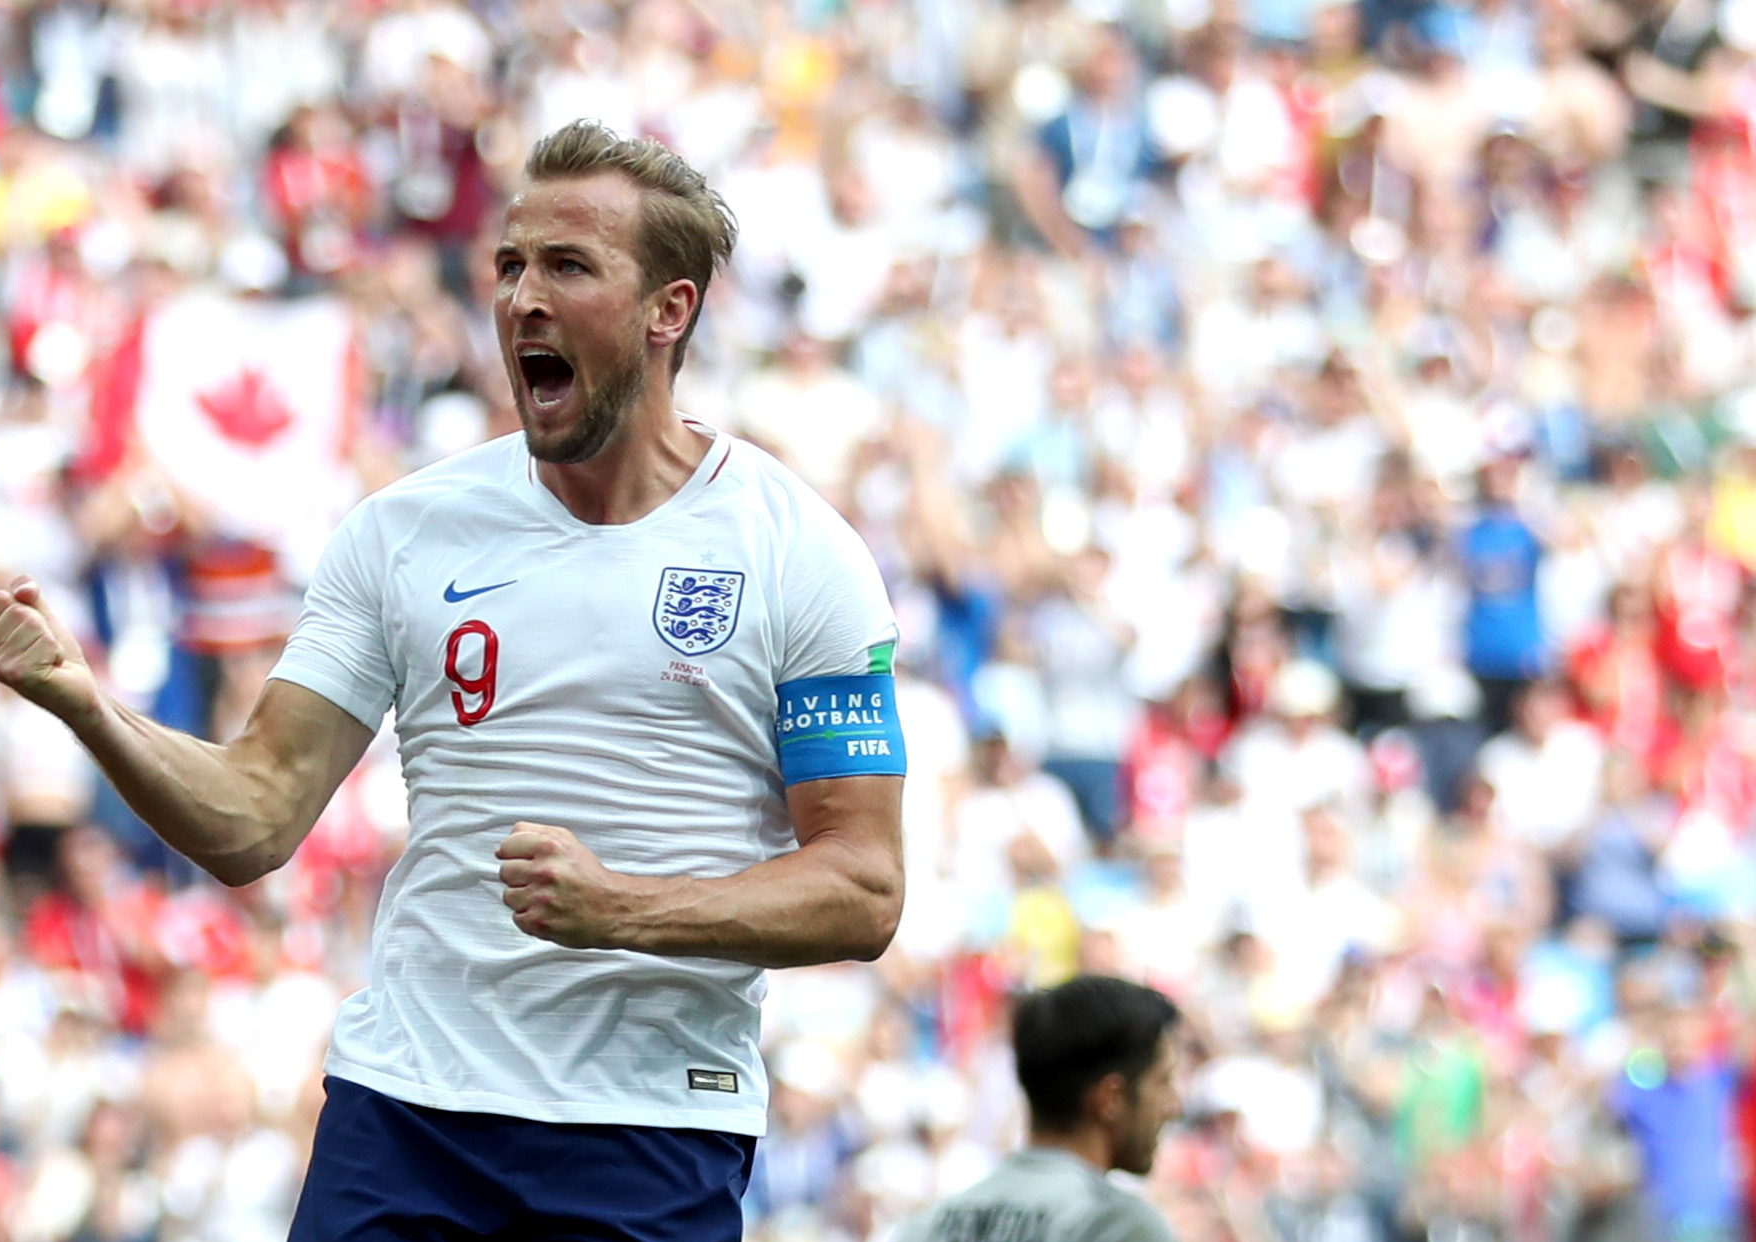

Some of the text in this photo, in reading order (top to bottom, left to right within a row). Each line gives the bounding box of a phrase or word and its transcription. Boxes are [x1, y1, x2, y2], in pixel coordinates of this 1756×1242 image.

[445, 619, 498, 726] 9
[669, 661, 704, 675] PANAMA
[776, 709, 883, 732] OOTBALL
[847, 740, 891, 756] FIFA
